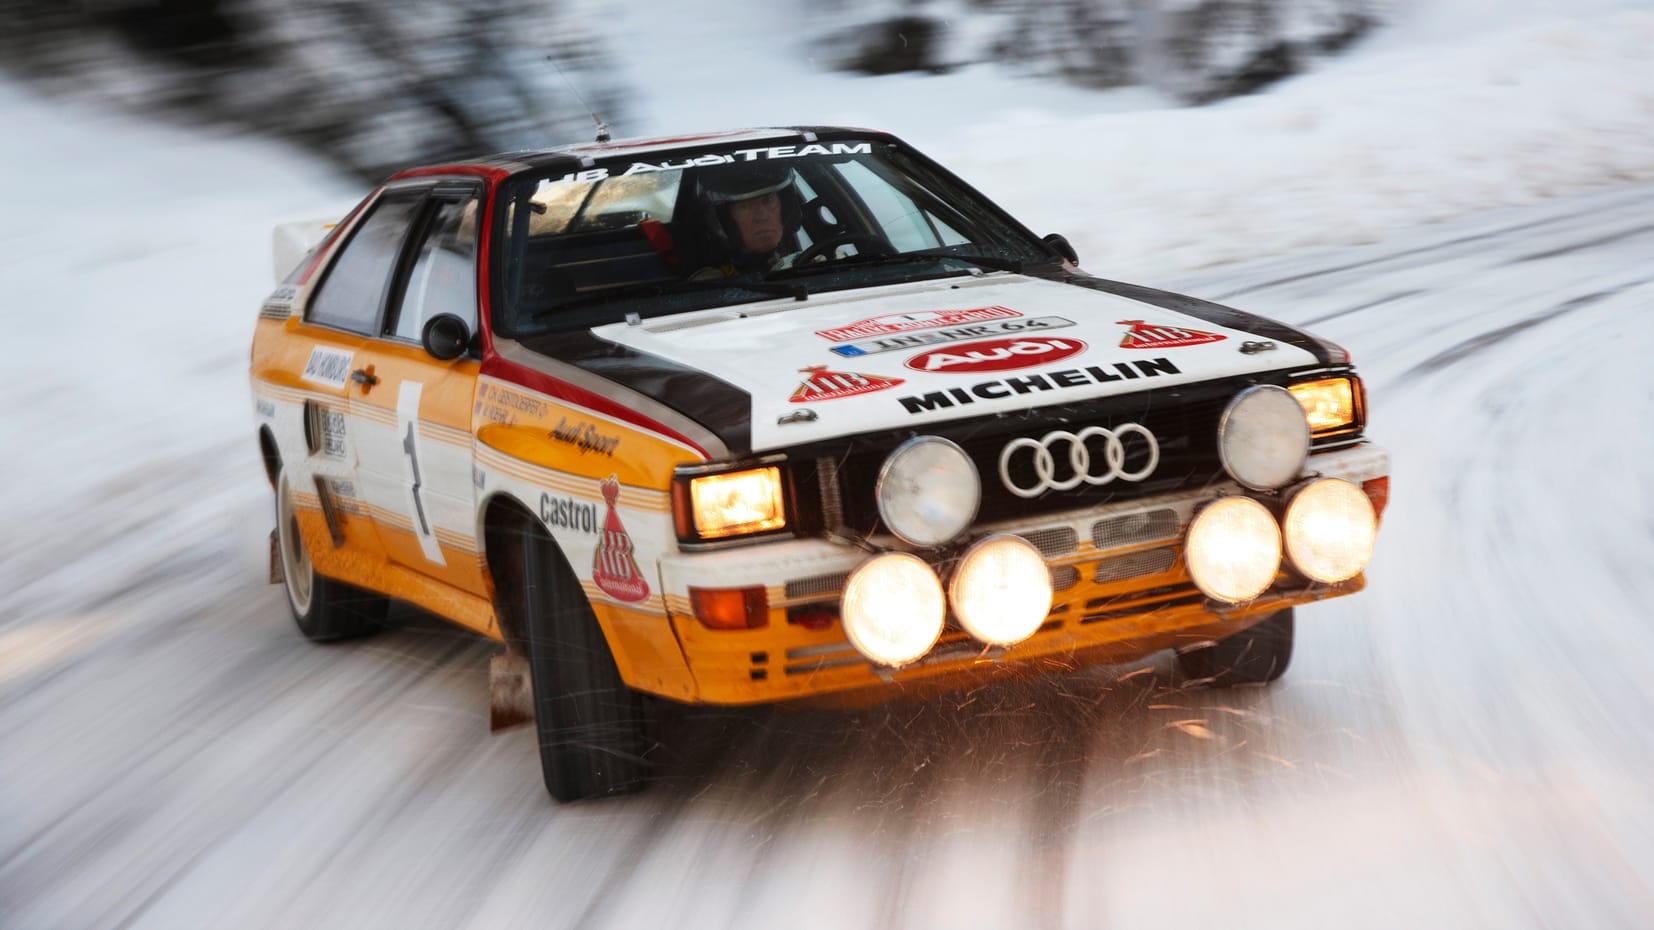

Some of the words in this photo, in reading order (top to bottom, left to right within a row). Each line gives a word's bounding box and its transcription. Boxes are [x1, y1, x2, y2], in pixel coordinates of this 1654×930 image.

[537, 167, 610, 192] HB
[733, 142, 873, 162] TEAM
[1000, 319, 1050, 332] 64
[898, 357, 1182, 414] MICHELIN
[403, 420, 431, 536] 1
[540, 491, 598, 534] Castrol
